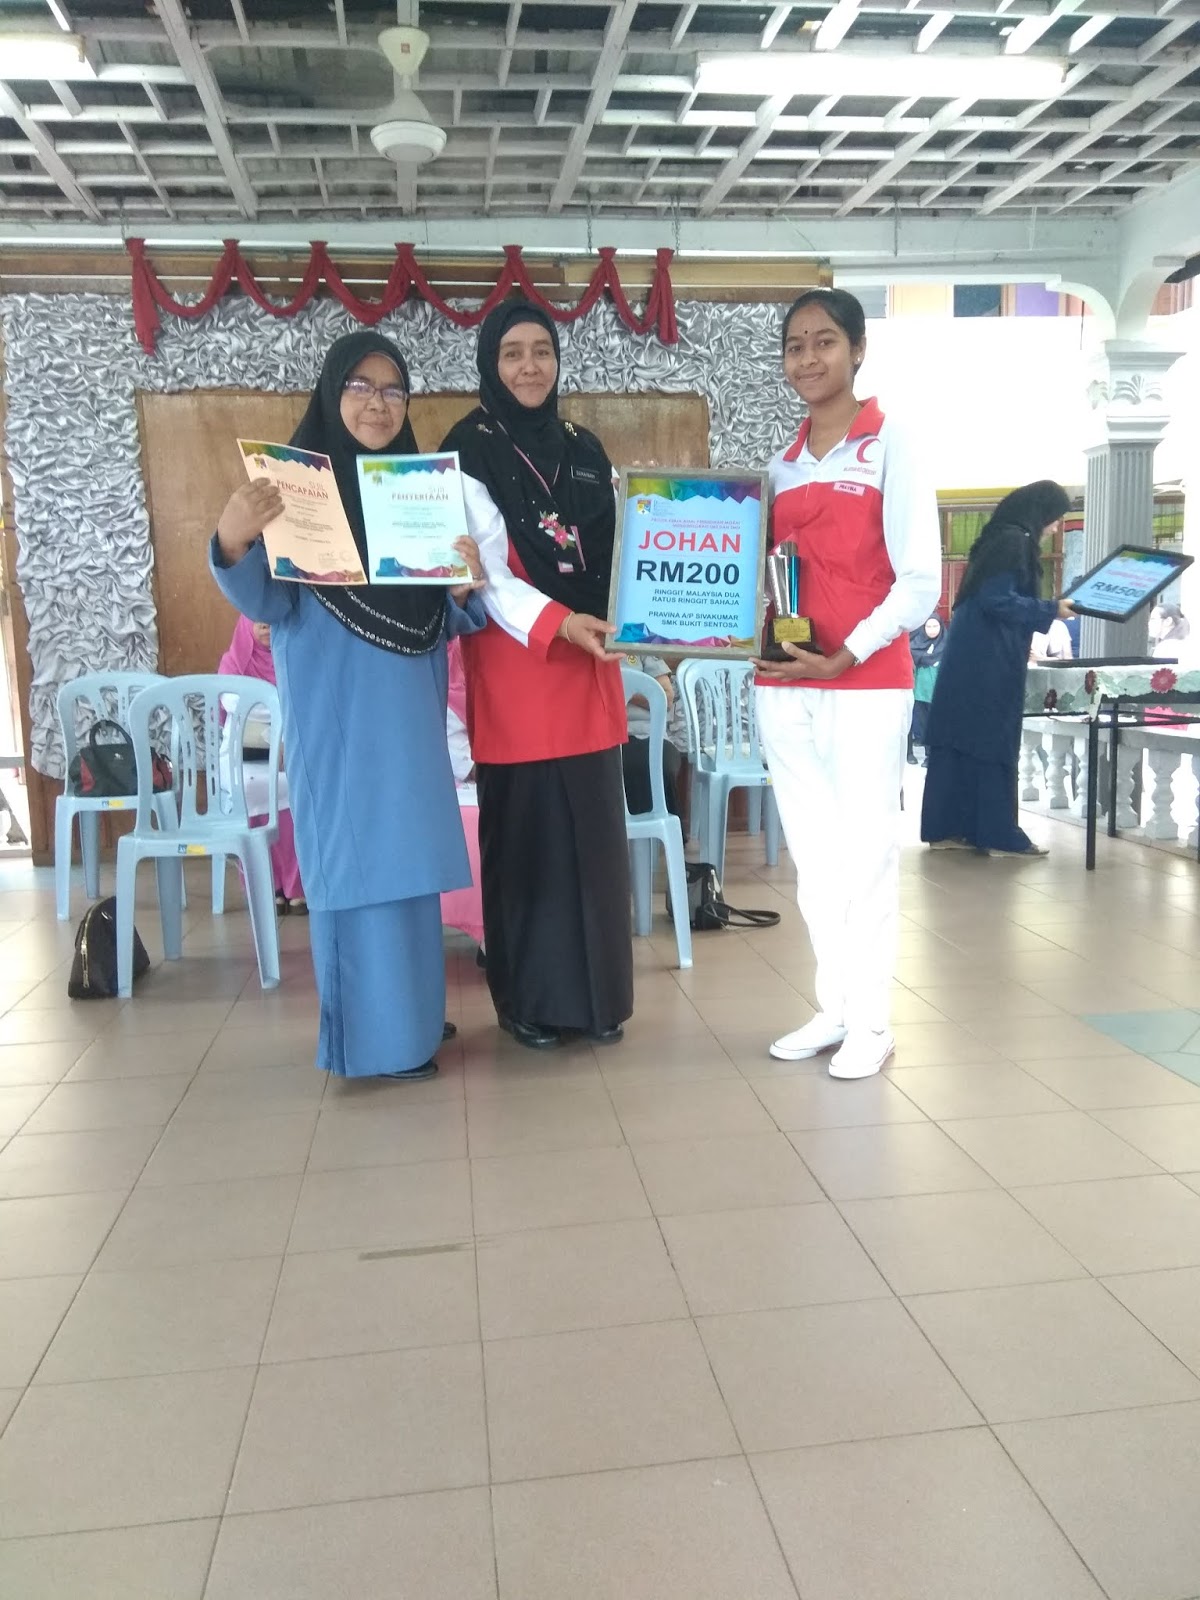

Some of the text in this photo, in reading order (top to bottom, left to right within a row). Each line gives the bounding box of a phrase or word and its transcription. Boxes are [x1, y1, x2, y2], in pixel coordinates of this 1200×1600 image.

[276, 479, 329, 499] PENCAPAIAN
[638, 530, 741, 553] JOHAN
[636, 559, 740, 585] RM200
[654, 588, 684, 596] RINGGIT
[685, 590, 723, 598] MALAYSIA
[1091, 582, 1147, 598] RM500
[648, 610, 680, 618] PRAVINA
[695, 613, 739, 621] SIVAKUMAR
[703, 621, 738, 629] SENTOSA
